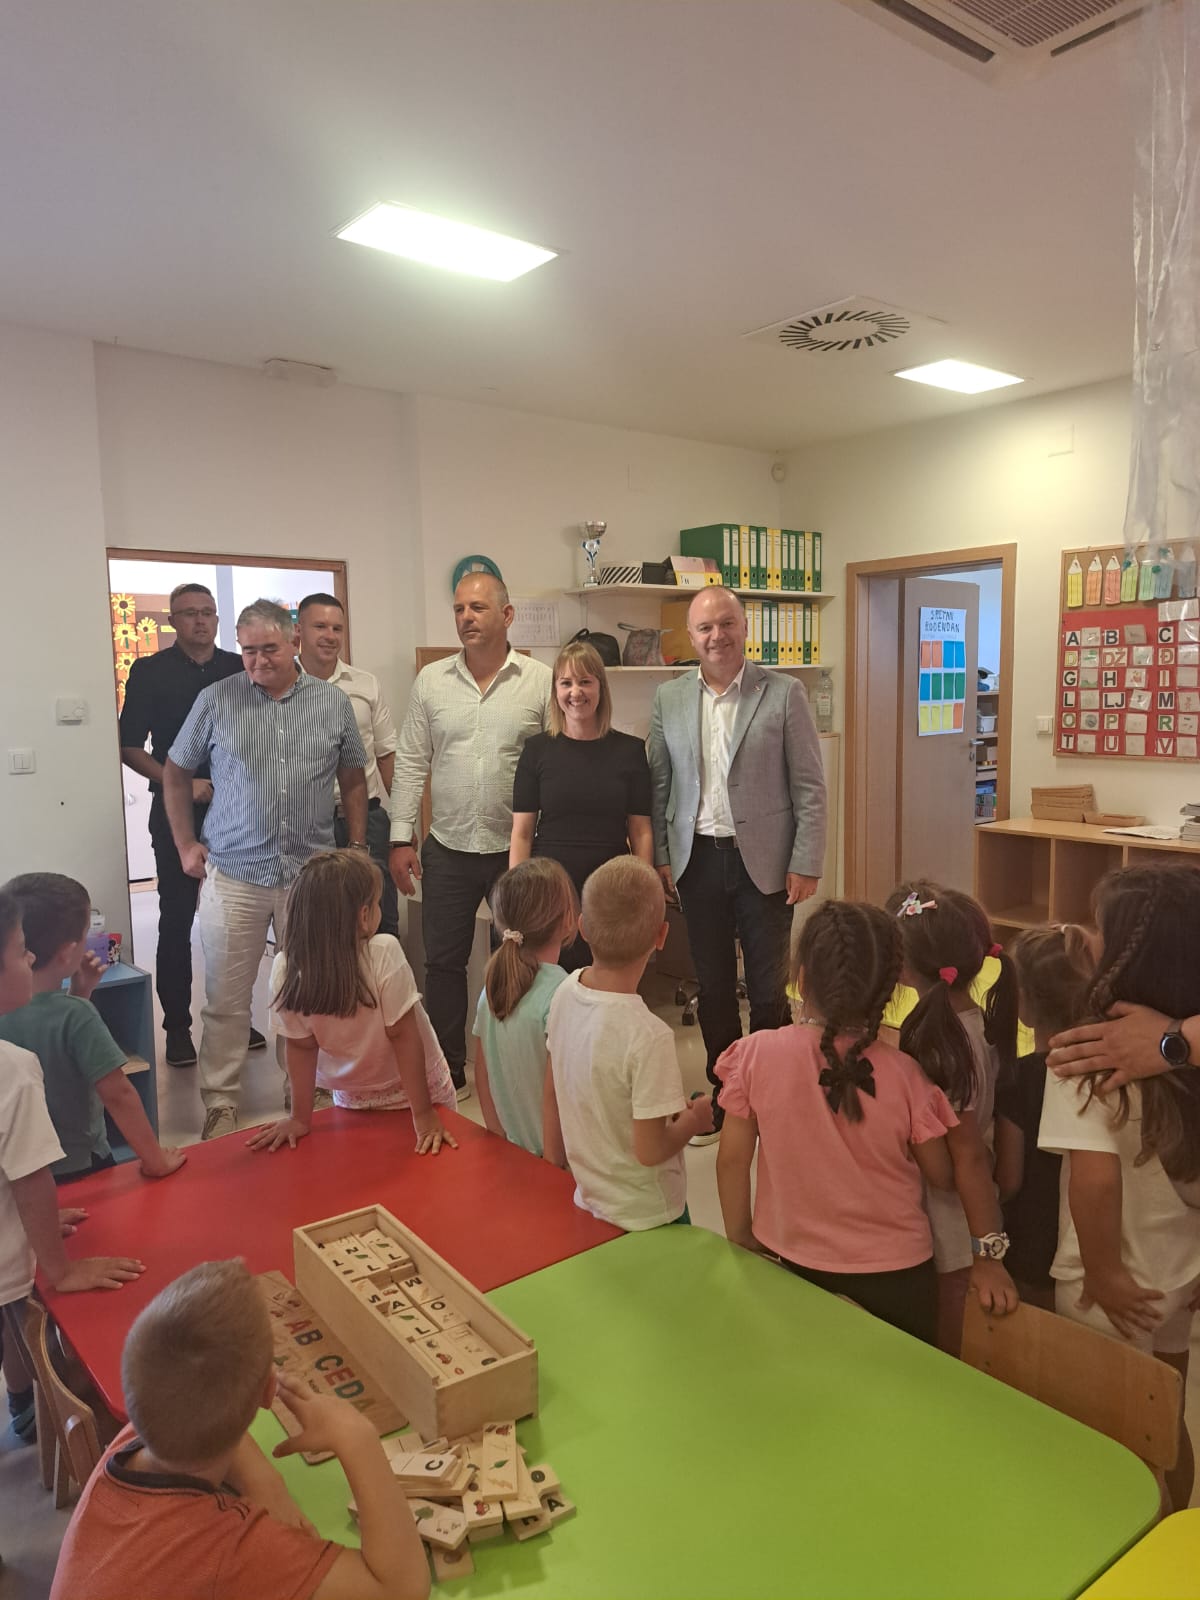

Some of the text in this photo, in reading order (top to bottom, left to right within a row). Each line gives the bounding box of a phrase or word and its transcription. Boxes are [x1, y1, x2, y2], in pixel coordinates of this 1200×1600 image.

[1067, 627, 1172, 646] A B C
[1065, 651, 1076, 666] D
[1103, 648, 1126, 667] DŽ
[1064, 671, 1076, 685] G
[1104, 671, 1116, 686] H
[1064, 692, 1173, 708] L LJ M
[1062, 713, 1172, 730] O P R
[1062, 733, 1172, 753] T U V
[392, 1300, 406, 1310] A
[414, 1326, 431, 1335] L
[424, 1459, 444, 1471] C
[546, 1498, 565, 1513] A
